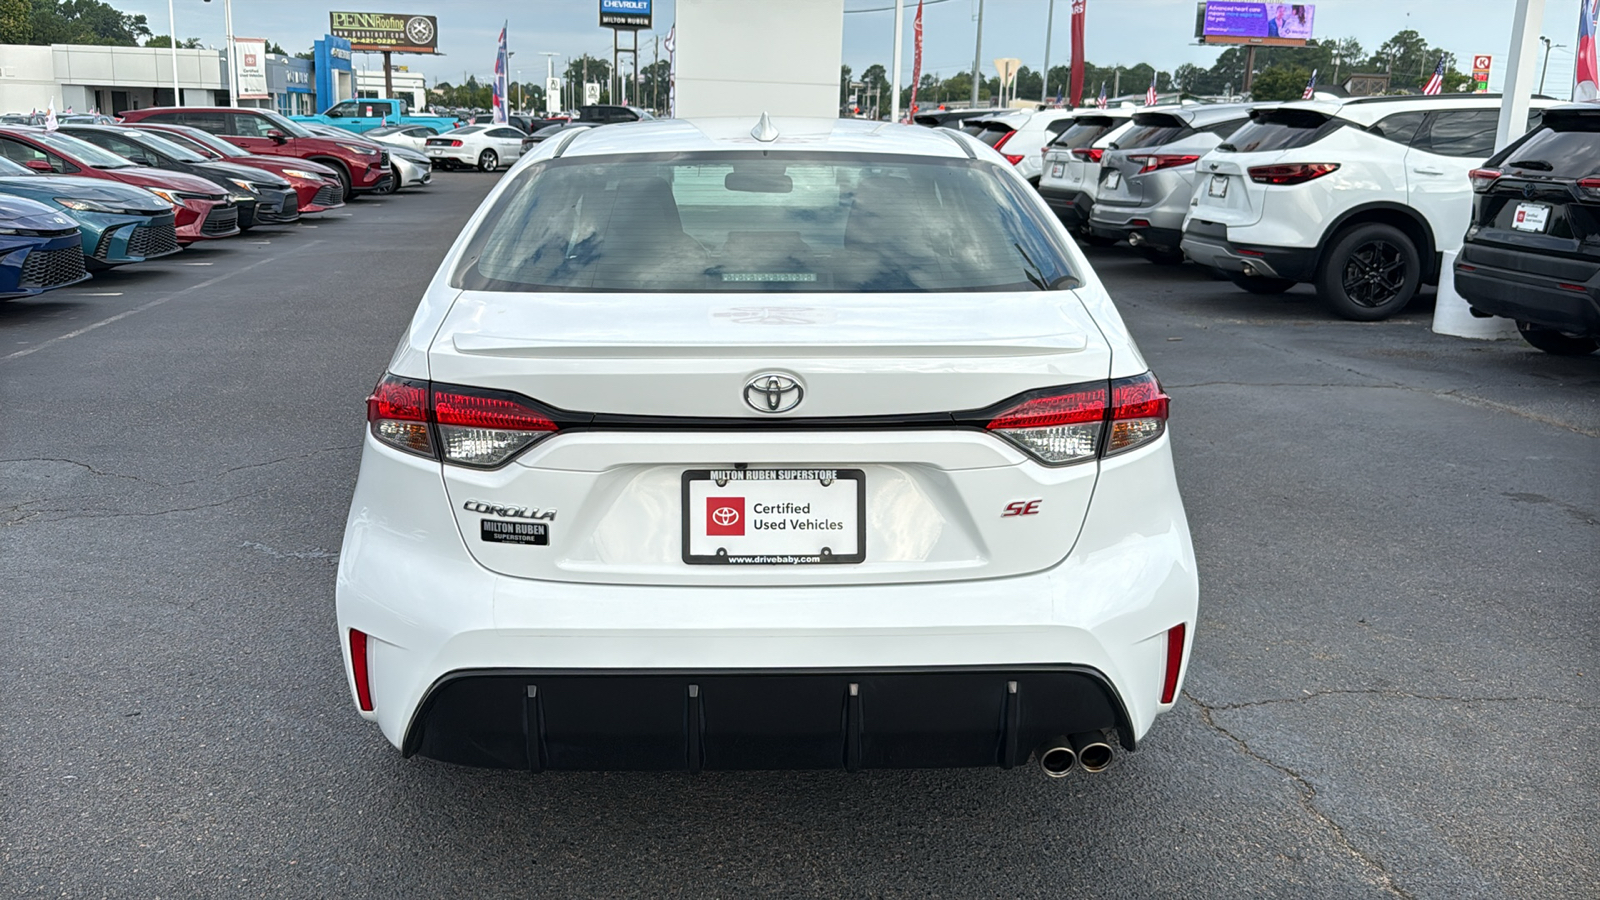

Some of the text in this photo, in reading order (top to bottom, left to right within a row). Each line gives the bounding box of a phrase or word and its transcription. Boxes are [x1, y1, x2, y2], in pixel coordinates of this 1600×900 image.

[603, 0, 648, 9] CHEVROLET
[332, 12, 384, 28] PENN
[375, 16, 404, 31] Roofing
[603, 16, 626, 24] MILTON
[710, 470, 838, 480] MILTON RUBEN SUPERSTORE
[463, 499, 557, 521] COROLLA
[753, 503, 810, 515] Certified
[1000, 498, 1042, 518] SE
[483, 521, 545, 535] MILTON RUBEN
[754, 519, 844, 531] Used Vehicles
[493, 532, 536, 542] SUPERSTORE
[728, 555, 821, 565] www.drivebaby.com
